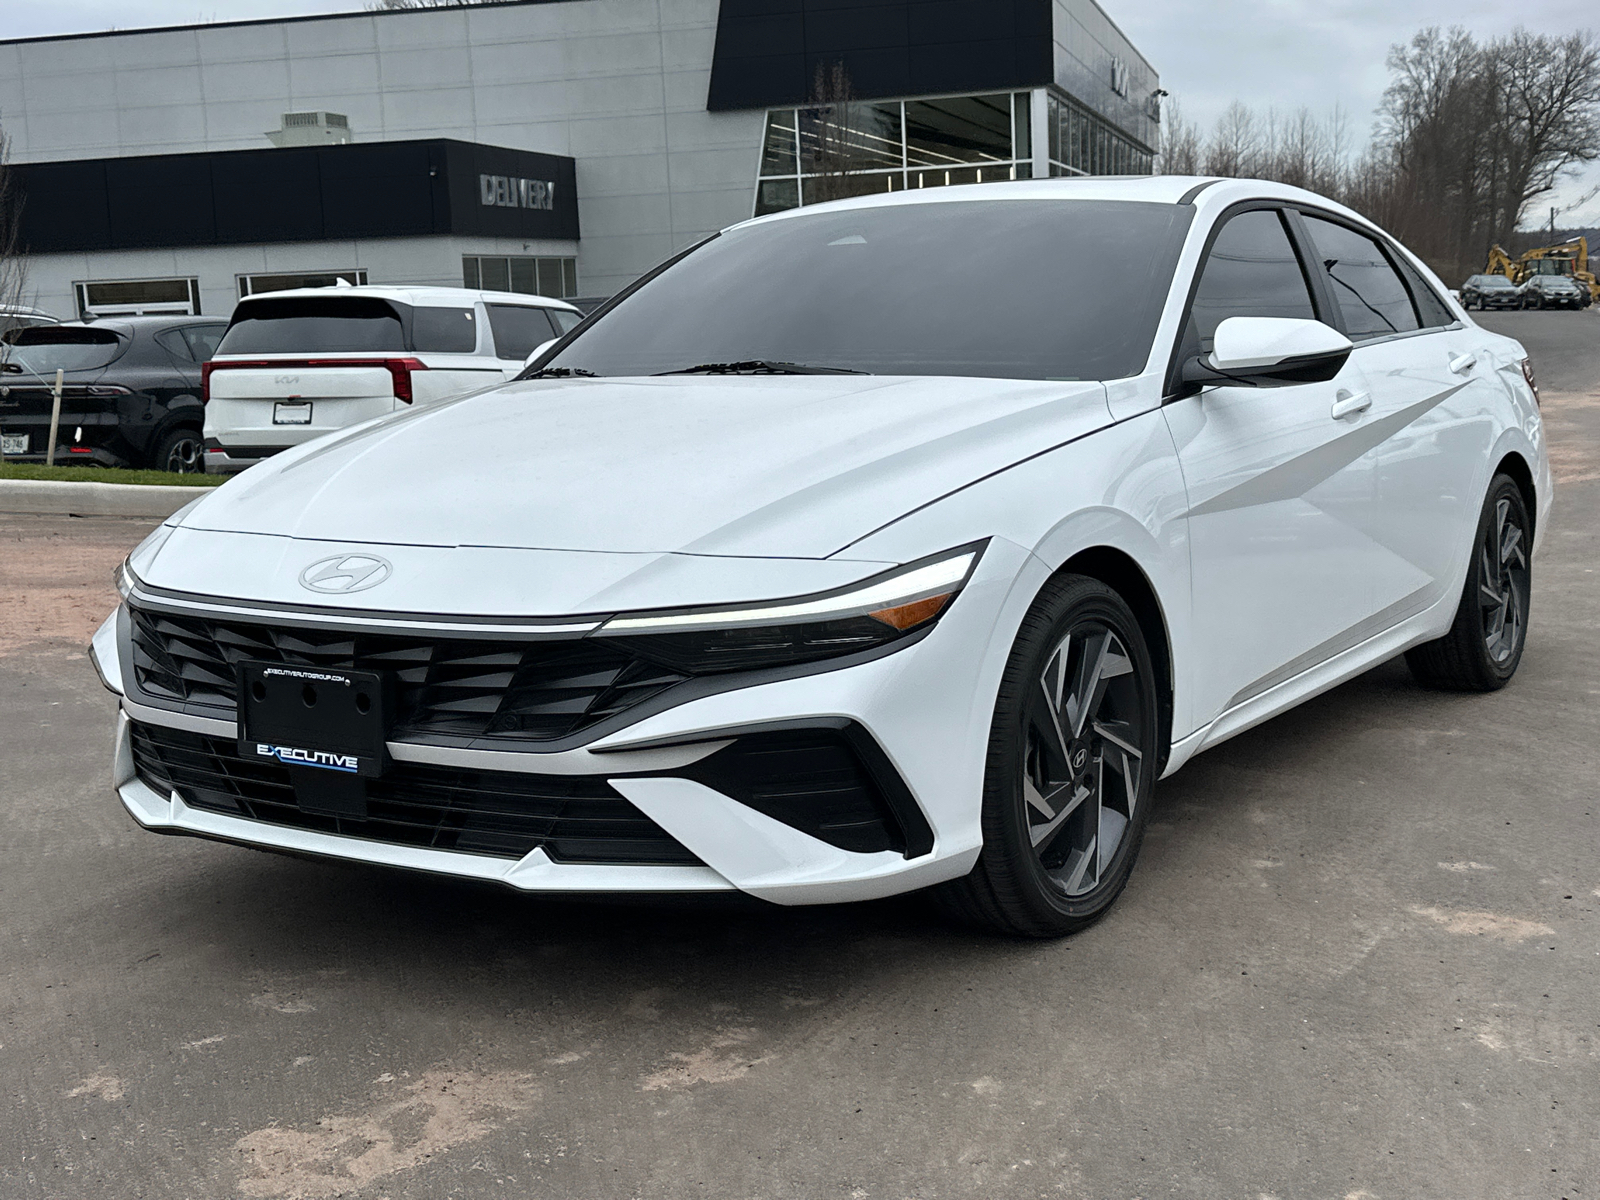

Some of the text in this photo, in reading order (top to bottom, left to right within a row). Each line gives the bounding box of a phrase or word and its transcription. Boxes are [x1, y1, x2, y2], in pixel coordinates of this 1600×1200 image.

[480, 173, 555, 211] DELIVERY
[266, 667, 345, 682] EXECUTIVEAUTOGROUP.COM
[256, 743, 358, 770] EXECUTIVE
